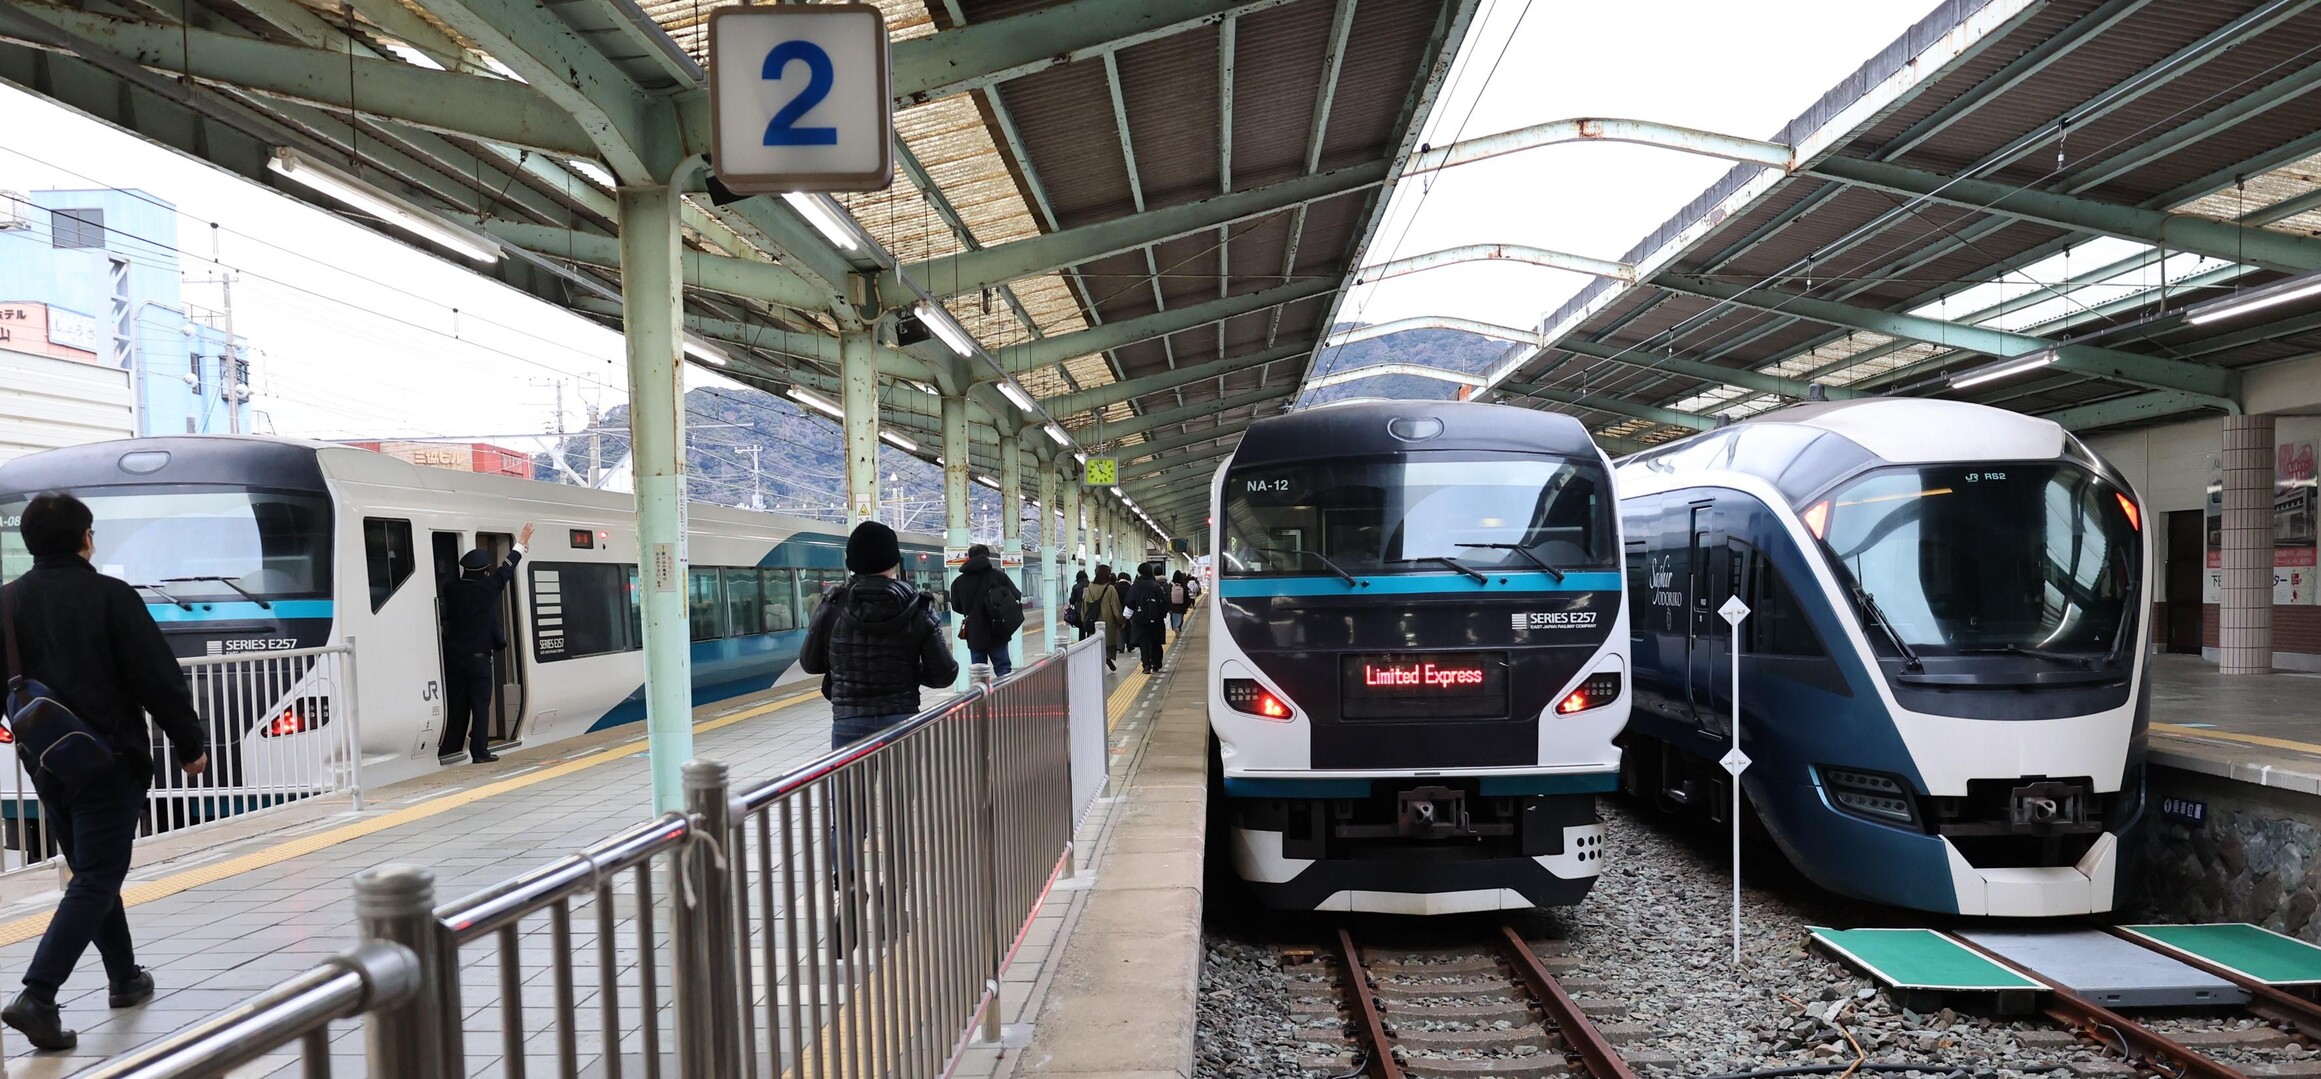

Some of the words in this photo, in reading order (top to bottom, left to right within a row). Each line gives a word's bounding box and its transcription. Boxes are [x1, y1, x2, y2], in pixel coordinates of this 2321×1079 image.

[761, 39, 837, 146] 2
[1984, 472, 2007, 480] RS2
[1247, 479, 1289, 492] NA-12
[1530, 612, 1568, 624] SERIES
[1570, 612, 1597, 623] E257
[225, 639, 267, 651] SERIES
[268, 638, 297, 649] E257
[1365, 664, 1420, 685] Limited
[1425, 664, 1482, 688] Express
[422, 680, 439, 701] JR
